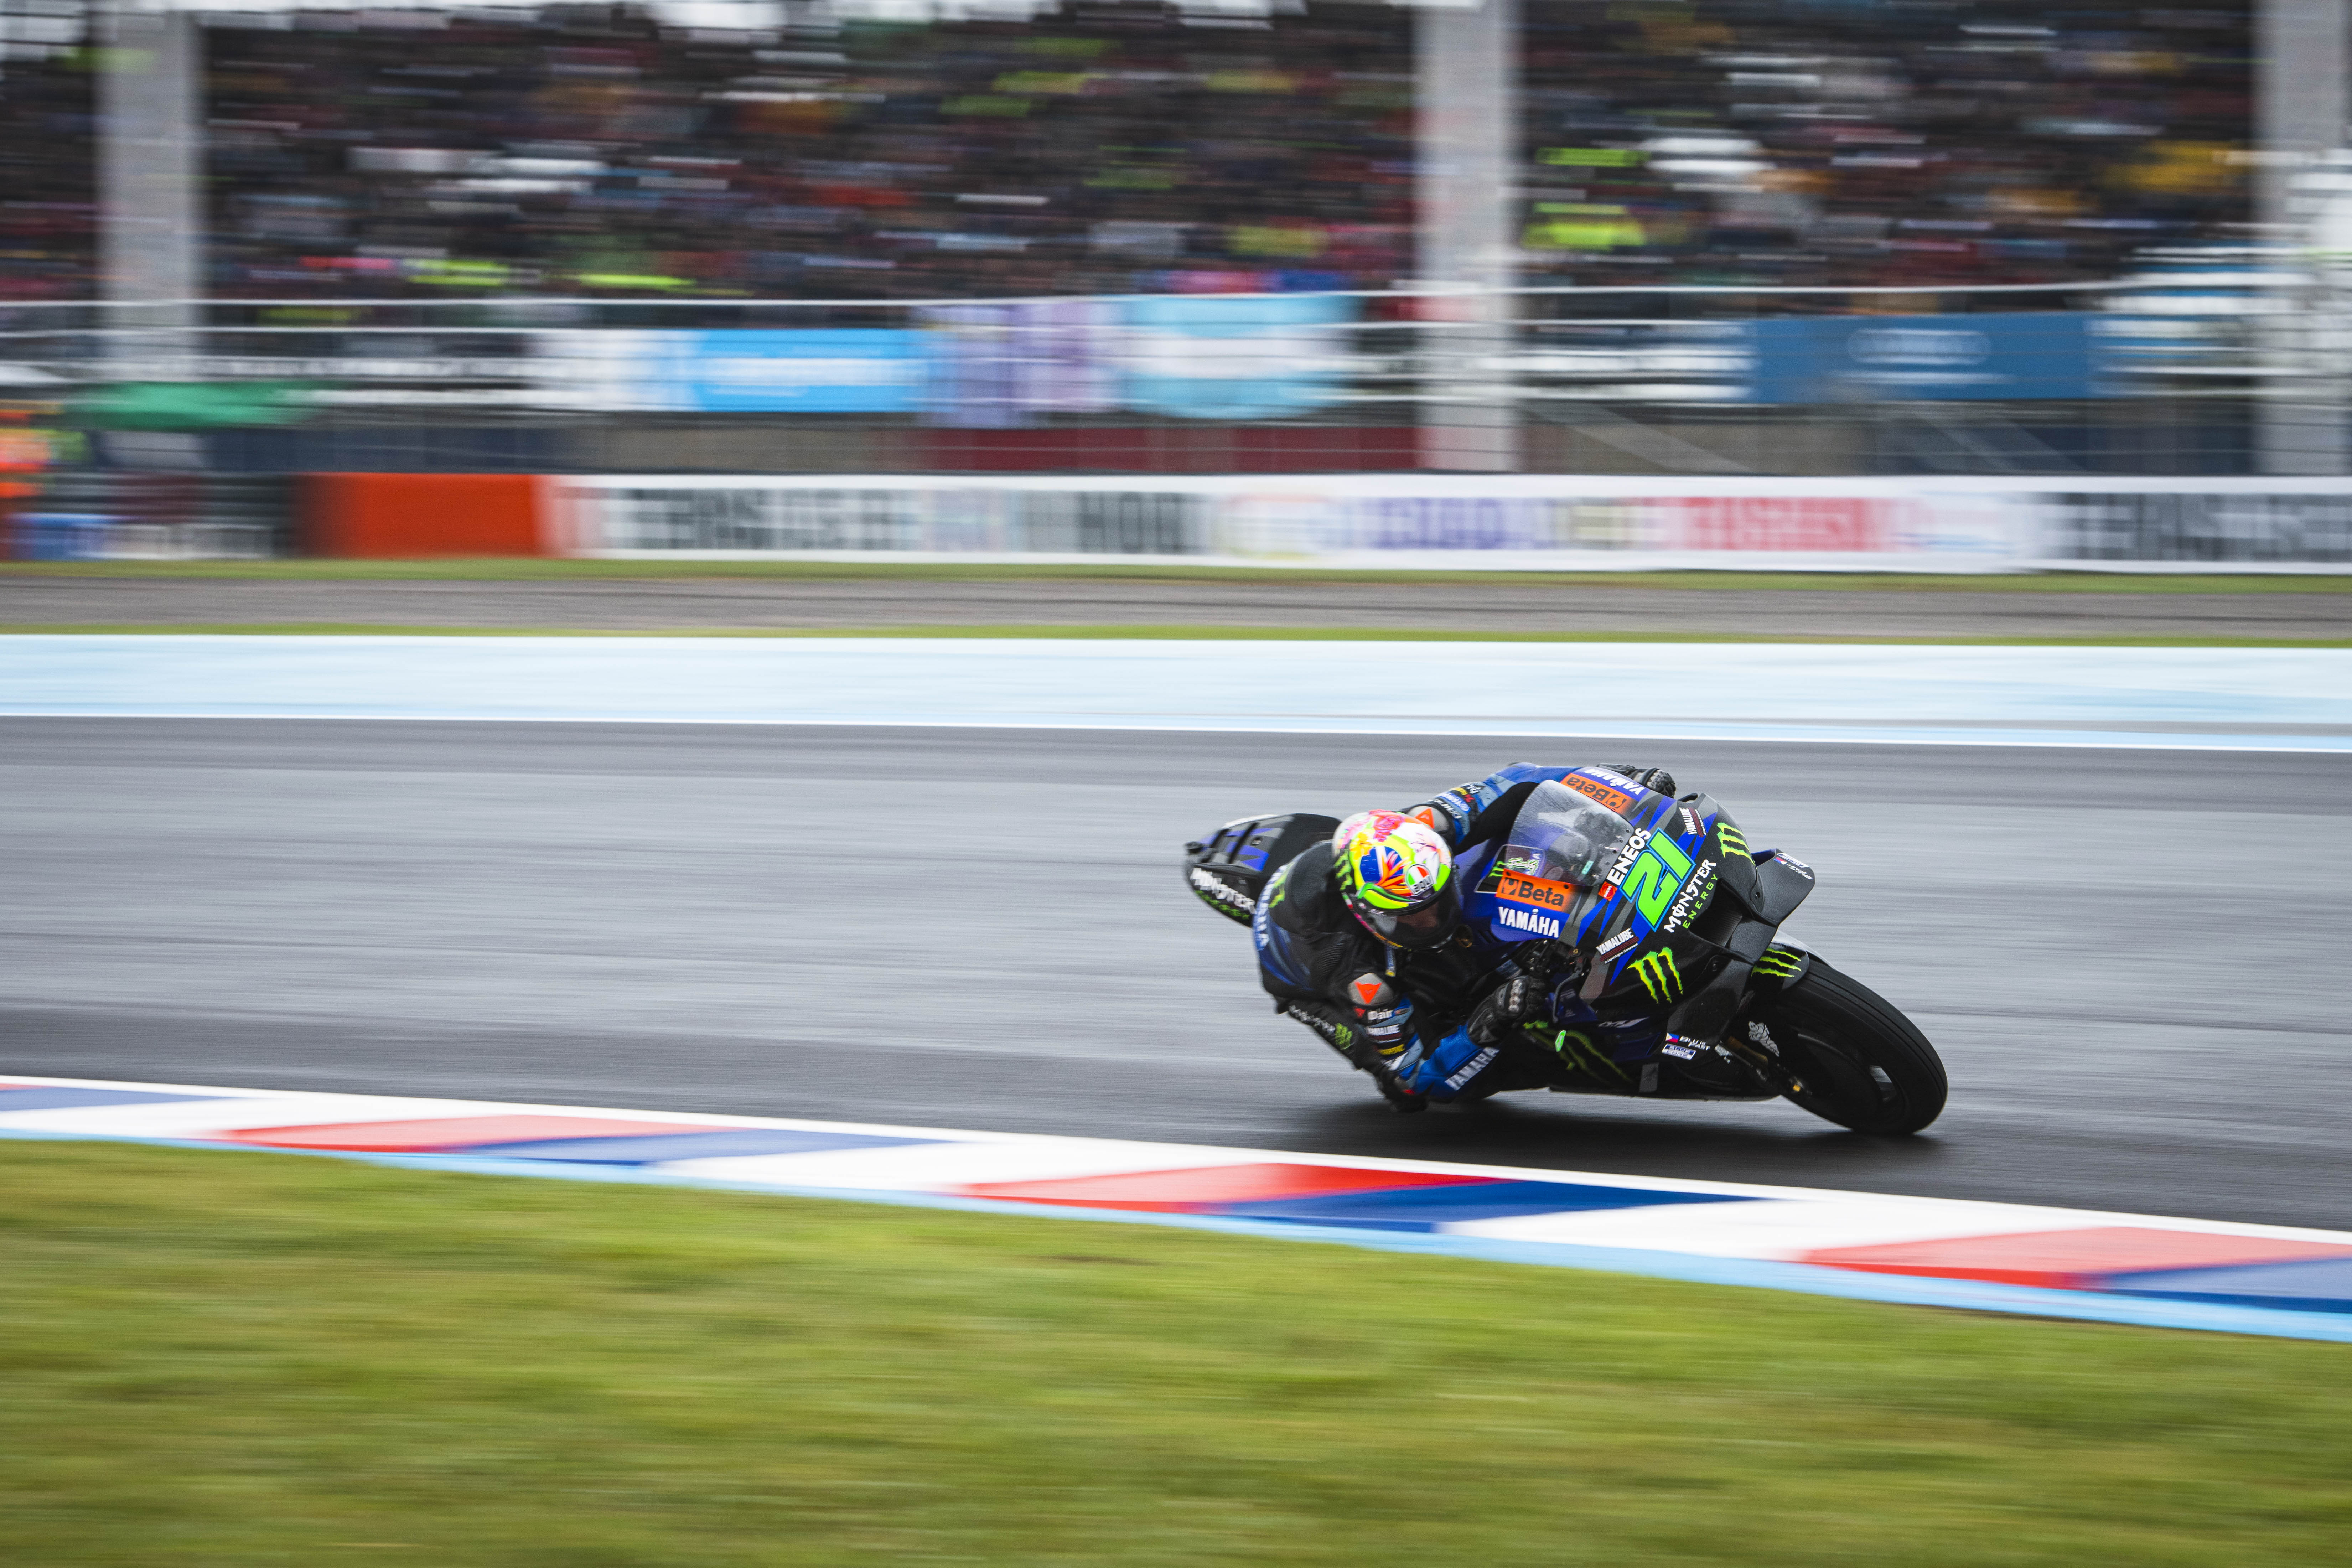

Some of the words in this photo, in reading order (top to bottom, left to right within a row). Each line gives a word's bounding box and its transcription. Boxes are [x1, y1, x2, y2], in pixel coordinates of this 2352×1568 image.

[1566, 777, 1611, 801] Beta
[1584, 769, 1645, 795] YAMAHA
[1679, 807, 1698, 835] YAMALUBE
[1606, 828, 1651, 885] ENEOS
[1518, 880, 1564, 906] Beta
[1603, 885, 1612, 897] ENEOS
[1619, 827, 1696, 932] 21
[1682, 874, 1718, 929] ENERGY
[1498, 906, 1559, 938] YAMAHA
[1596, 927, 1634, 955] YAMALUBE
[1444, 1047, 1500, 1091] YAMAHA
